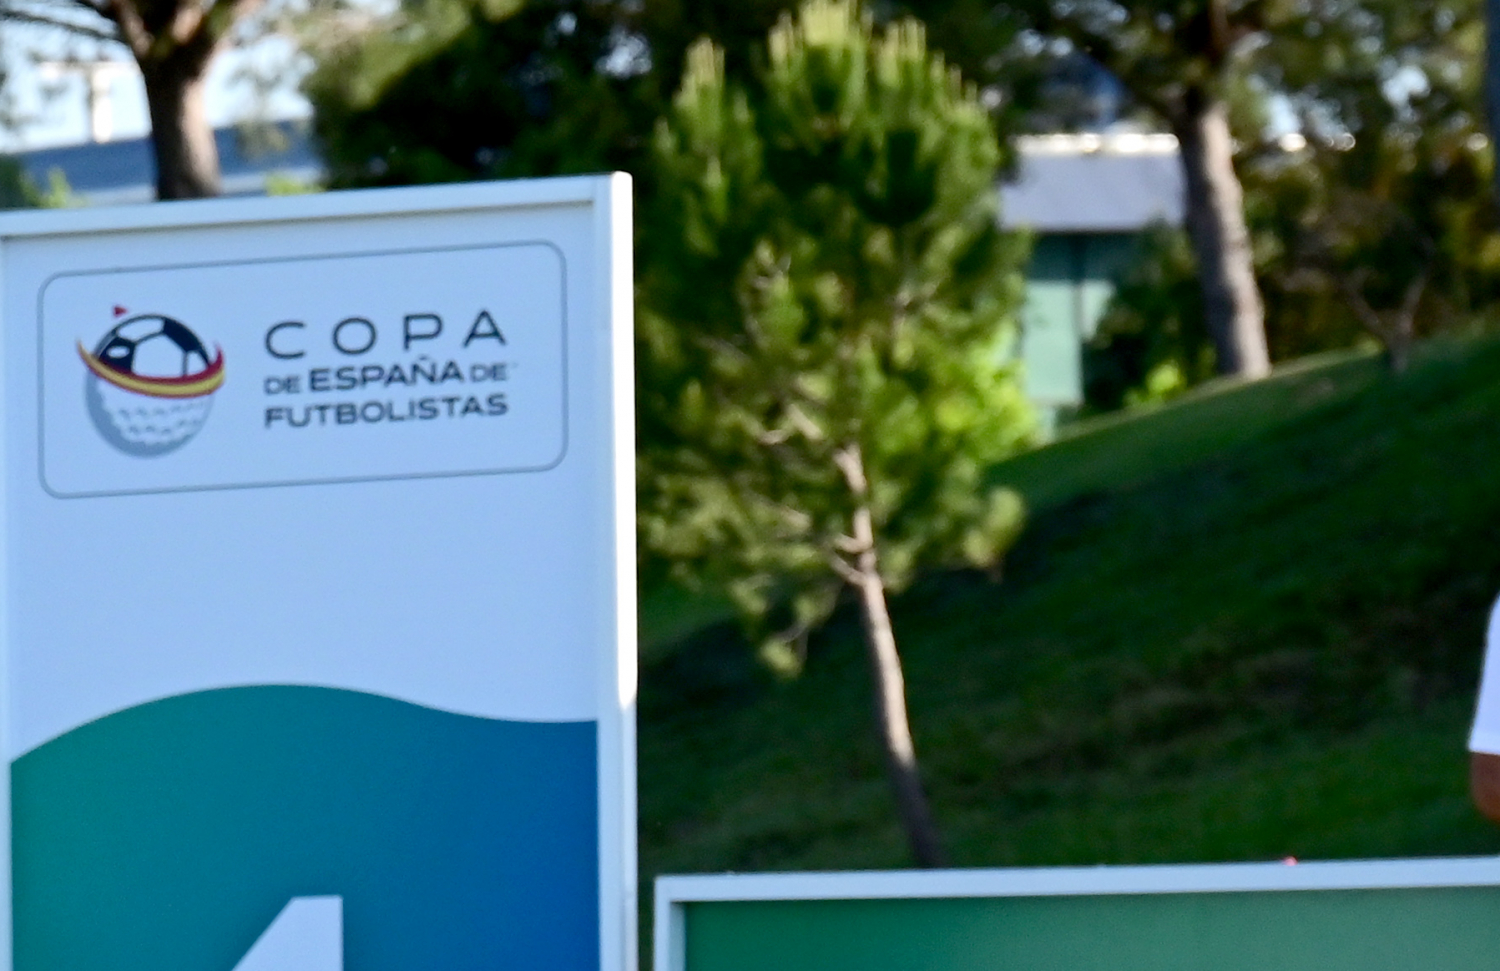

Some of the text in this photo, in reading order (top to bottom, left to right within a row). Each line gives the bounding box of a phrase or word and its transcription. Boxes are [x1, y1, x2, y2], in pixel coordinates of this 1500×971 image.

[264, 308, 507, 359] COPA
[264, 355, 508, 395] DE ESPAÑA DE
[265, 393, 508, 428] FUTBOLISTAS
